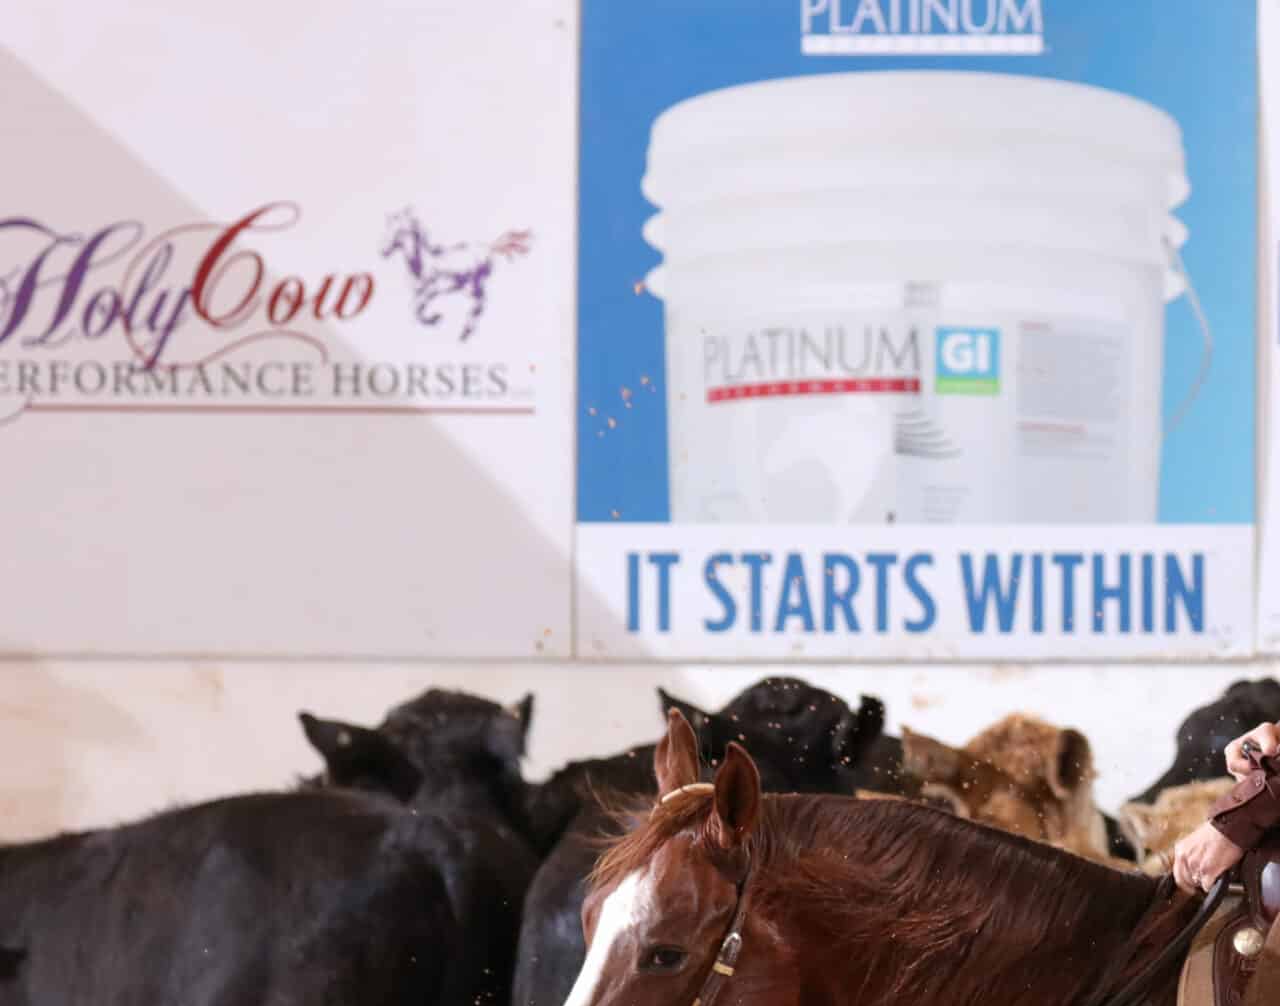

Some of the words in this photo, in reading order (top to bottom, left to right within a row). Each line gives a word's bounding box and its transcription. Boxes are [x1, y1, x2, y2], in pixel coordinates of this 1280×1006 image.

[800, 0, 1044, 34] PLATINUM
[703, 322, 922, 383] PLATINUM
[939, 331, 992, 374] GI
[0, 359, 315, 397] ERFORMANCE
[332, 363, 509, 398] HORSES
[626, 552, 680, 635] IT
[703, 551, 937, 637] STARTS
[959, 552, 1207, 635] WITHIN
